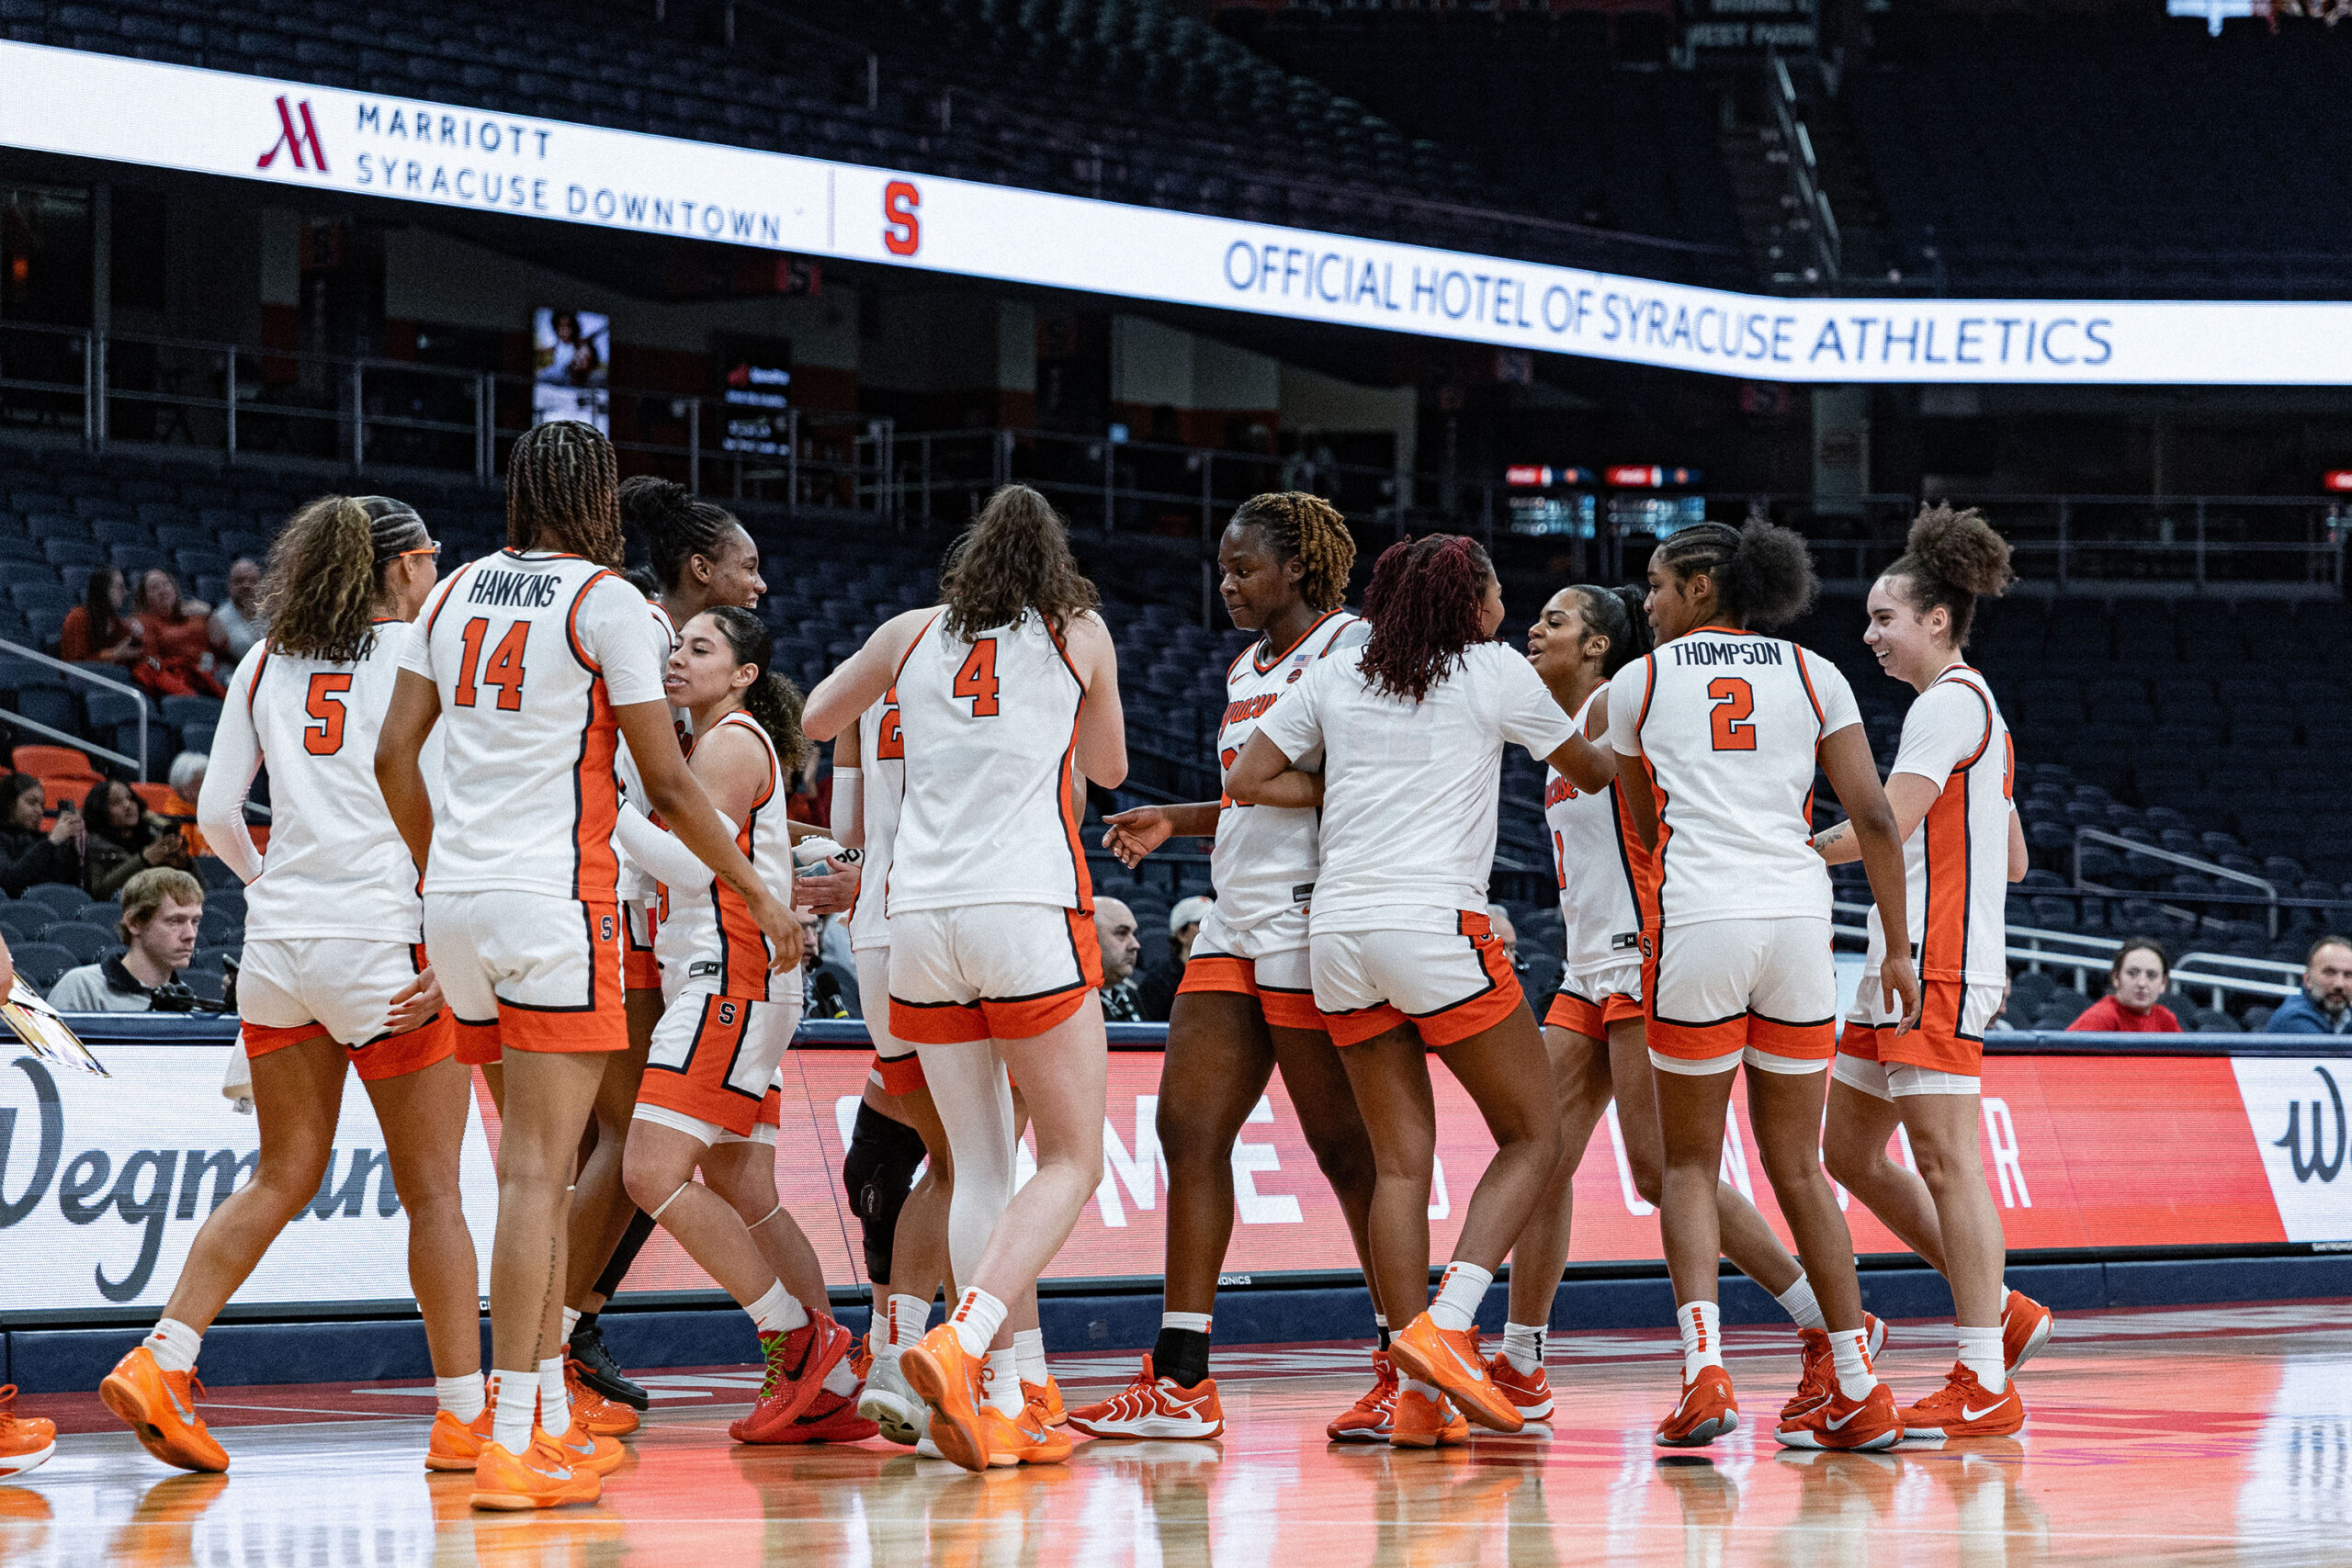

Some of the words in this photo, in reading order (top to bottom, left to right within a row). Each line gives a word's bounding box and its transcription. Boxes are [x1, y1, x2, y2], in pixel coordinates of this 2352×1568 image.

[356, 102, 551, 159] MARRIOTT
[356, 152, 548, 210] SYRACUSE
[568, 184, 782, 243] DOWNTOWN
[882, 178, 922, 258] S
[1224, 240, 1401, 312] OFFICIAL
[1411, 266, 1532, 330] HOTEL
[1543, 285, 1595, 335] OF
[1600, 292, 1798, 363] SYRACUSE
[1808, 318, 2113, 366] ATHLETICS
[468, 570, 562, 607] HAWKINS
[455, 616, 532, 712] 14
[953, 637, 1000, 718] 4
[1670, 641, 1782, 666] THOMPSON
[303, 672, 354, 756] 5
[1707, 677, 1758, 751] 2
[718, 1001, 737, 1026] S
